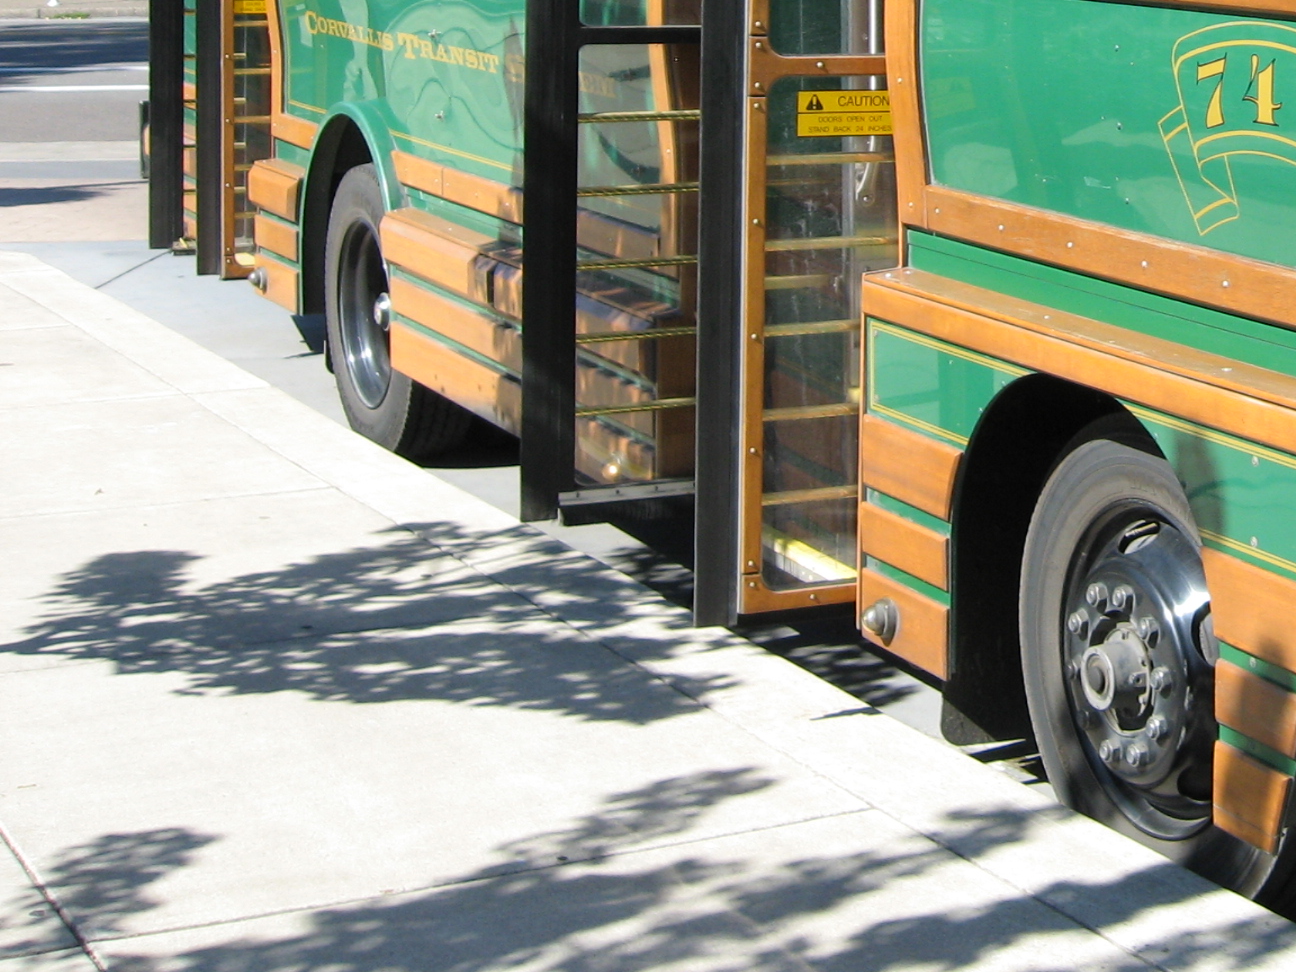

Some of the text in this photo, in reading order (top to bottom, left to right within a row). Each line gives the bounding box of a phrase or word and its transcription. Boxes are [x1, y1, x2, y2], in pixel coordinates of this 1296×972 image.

[397, 31, 499, 74] TRANSIT
[837, 95, 890, 107] CAUTION
[818, 115, 843, 123] DOORS
[846, 115, 866, 123] OPEN
